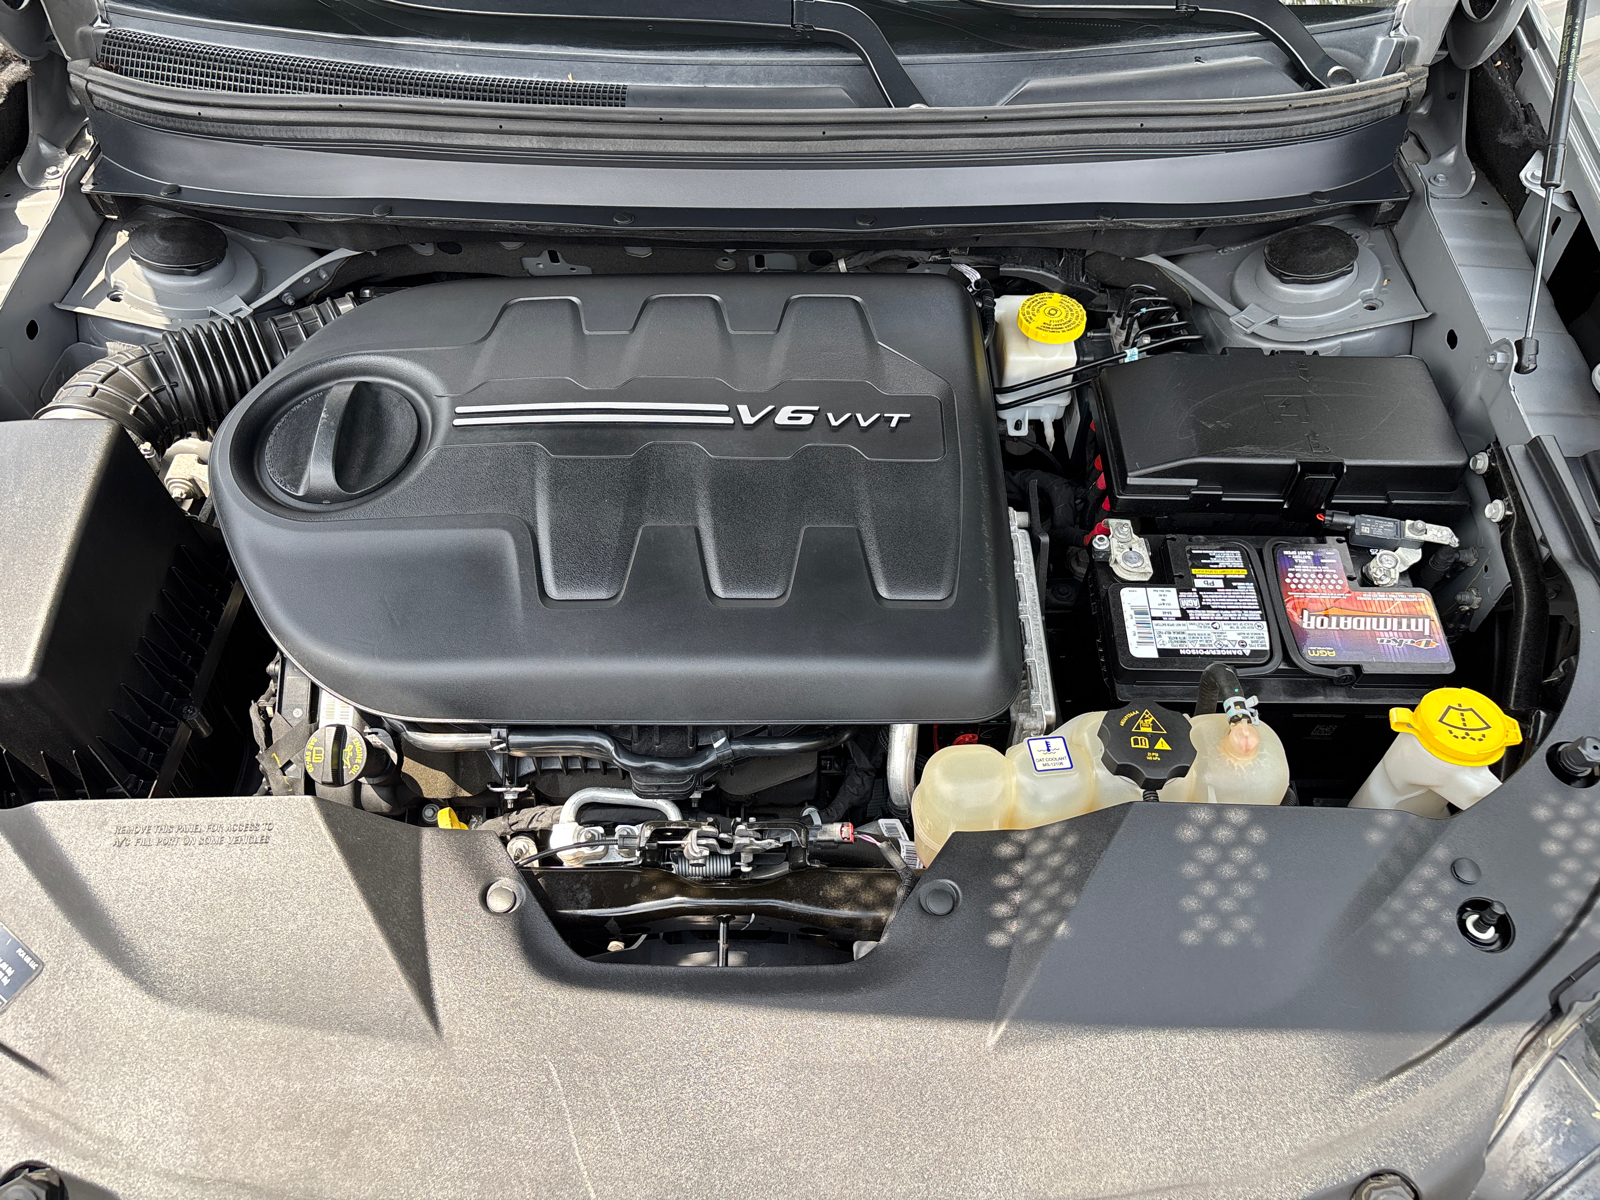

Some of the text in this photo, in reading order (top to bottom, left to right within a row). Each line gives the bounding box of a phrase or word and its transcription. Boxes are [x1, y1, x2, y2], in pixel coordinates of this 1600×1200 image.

[736, 404, 911, 428] V6 VVT
[1301, 609, 1430, 635] INTIMIDATOR
[305, 737, 318, 772] SAE 5W-20
[349, 738, 363, 775] ENGINE OIL
[114, 822, 274, 835] REMOVE THIS PANEL FOR ACCESS TO
[113, 835, 271, 848] A/C FILL PORT ON SOME VEHICLES
